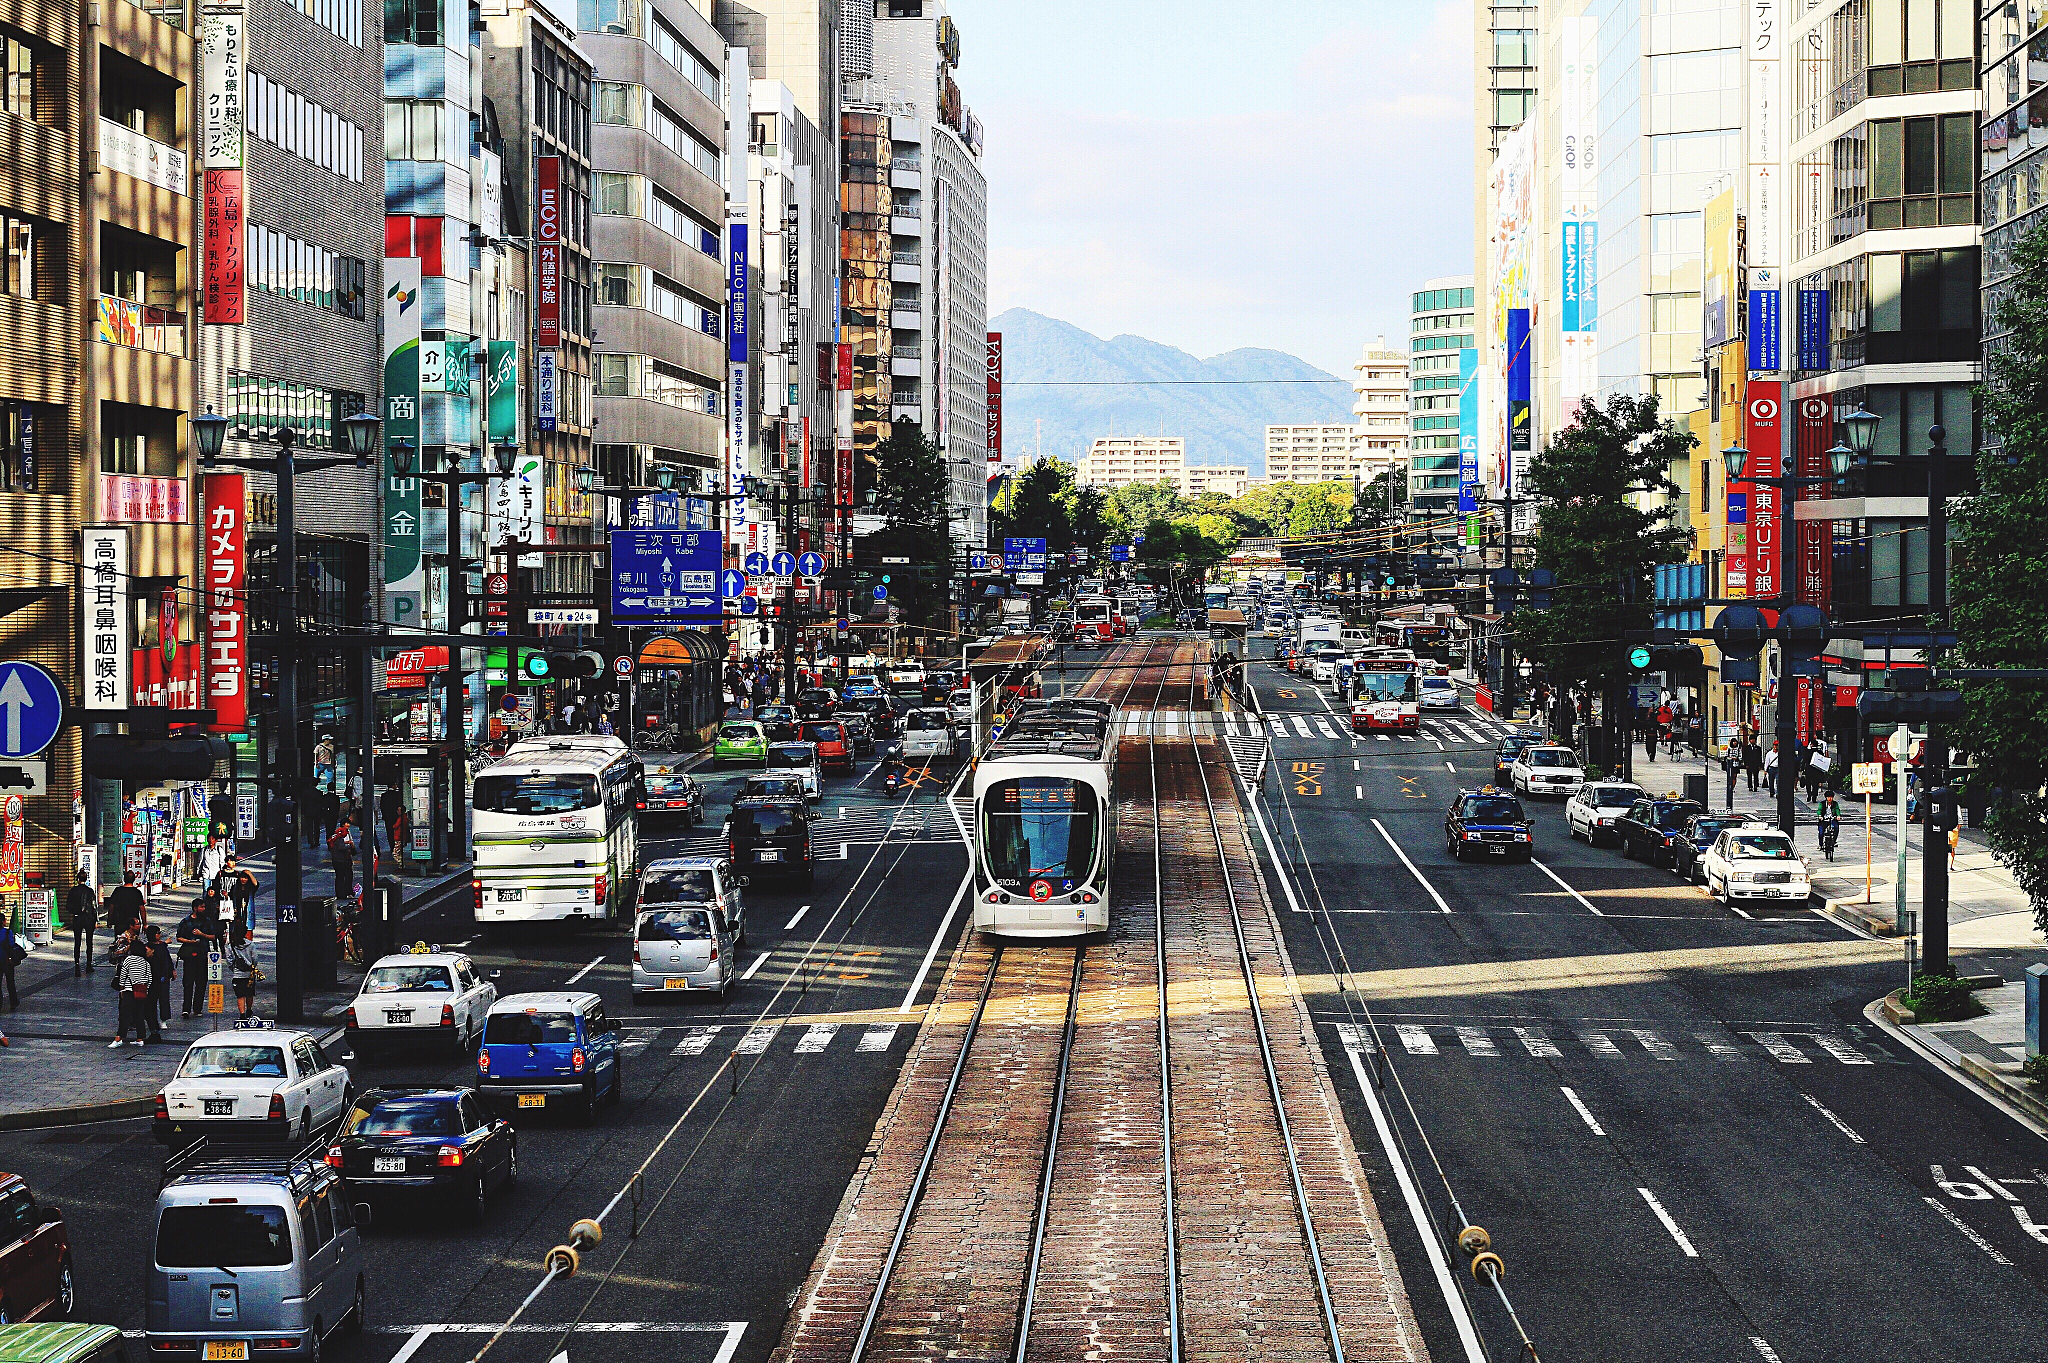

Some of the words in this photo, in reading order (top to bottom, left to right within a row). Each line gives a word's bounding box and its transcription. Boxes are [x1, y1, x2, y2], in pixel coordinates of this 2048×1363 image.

[225, 24, 238, 121] もりた心療内科
[208, 94, 220, 158] クリニック
[1566, 135, 1576, 169] CROP
[540, 189, 557, 238] ECC
[224, 196, 237, 318] 広島マーククリニック
[541, 247, 557, 304] 外語学院
[788, 225, 798, 323] 東京アカデミー広島校
[733, 251, 745, 334] NEC中国支社
[541, 355, 553, 414] 本通り歯科
[541, 419, 553, 428] 3F
[1461, 434, 1477, 498] 広島銀行
[635, 534, 663, 546] 三次
[670, 534, 699, 546] 可部
[1755, 456, 1773, 599] 三菱東京UFJ銀
[209, 505, 242, 697] カメラのサエダ
[619, 572, 648, 584] 横川
[661, 574, 672, 583] 54
[683, 574, 712, 583] 広島駅
[94, 537, 118, 703] 高橋耳鼻咽喉科
[394, 597, 414, 622] P
[210, 1105, 232, 1115] 38-86
[381, 1161, 404, 1172] 25-80
[214, 1347, 243, 1360] 13-60
